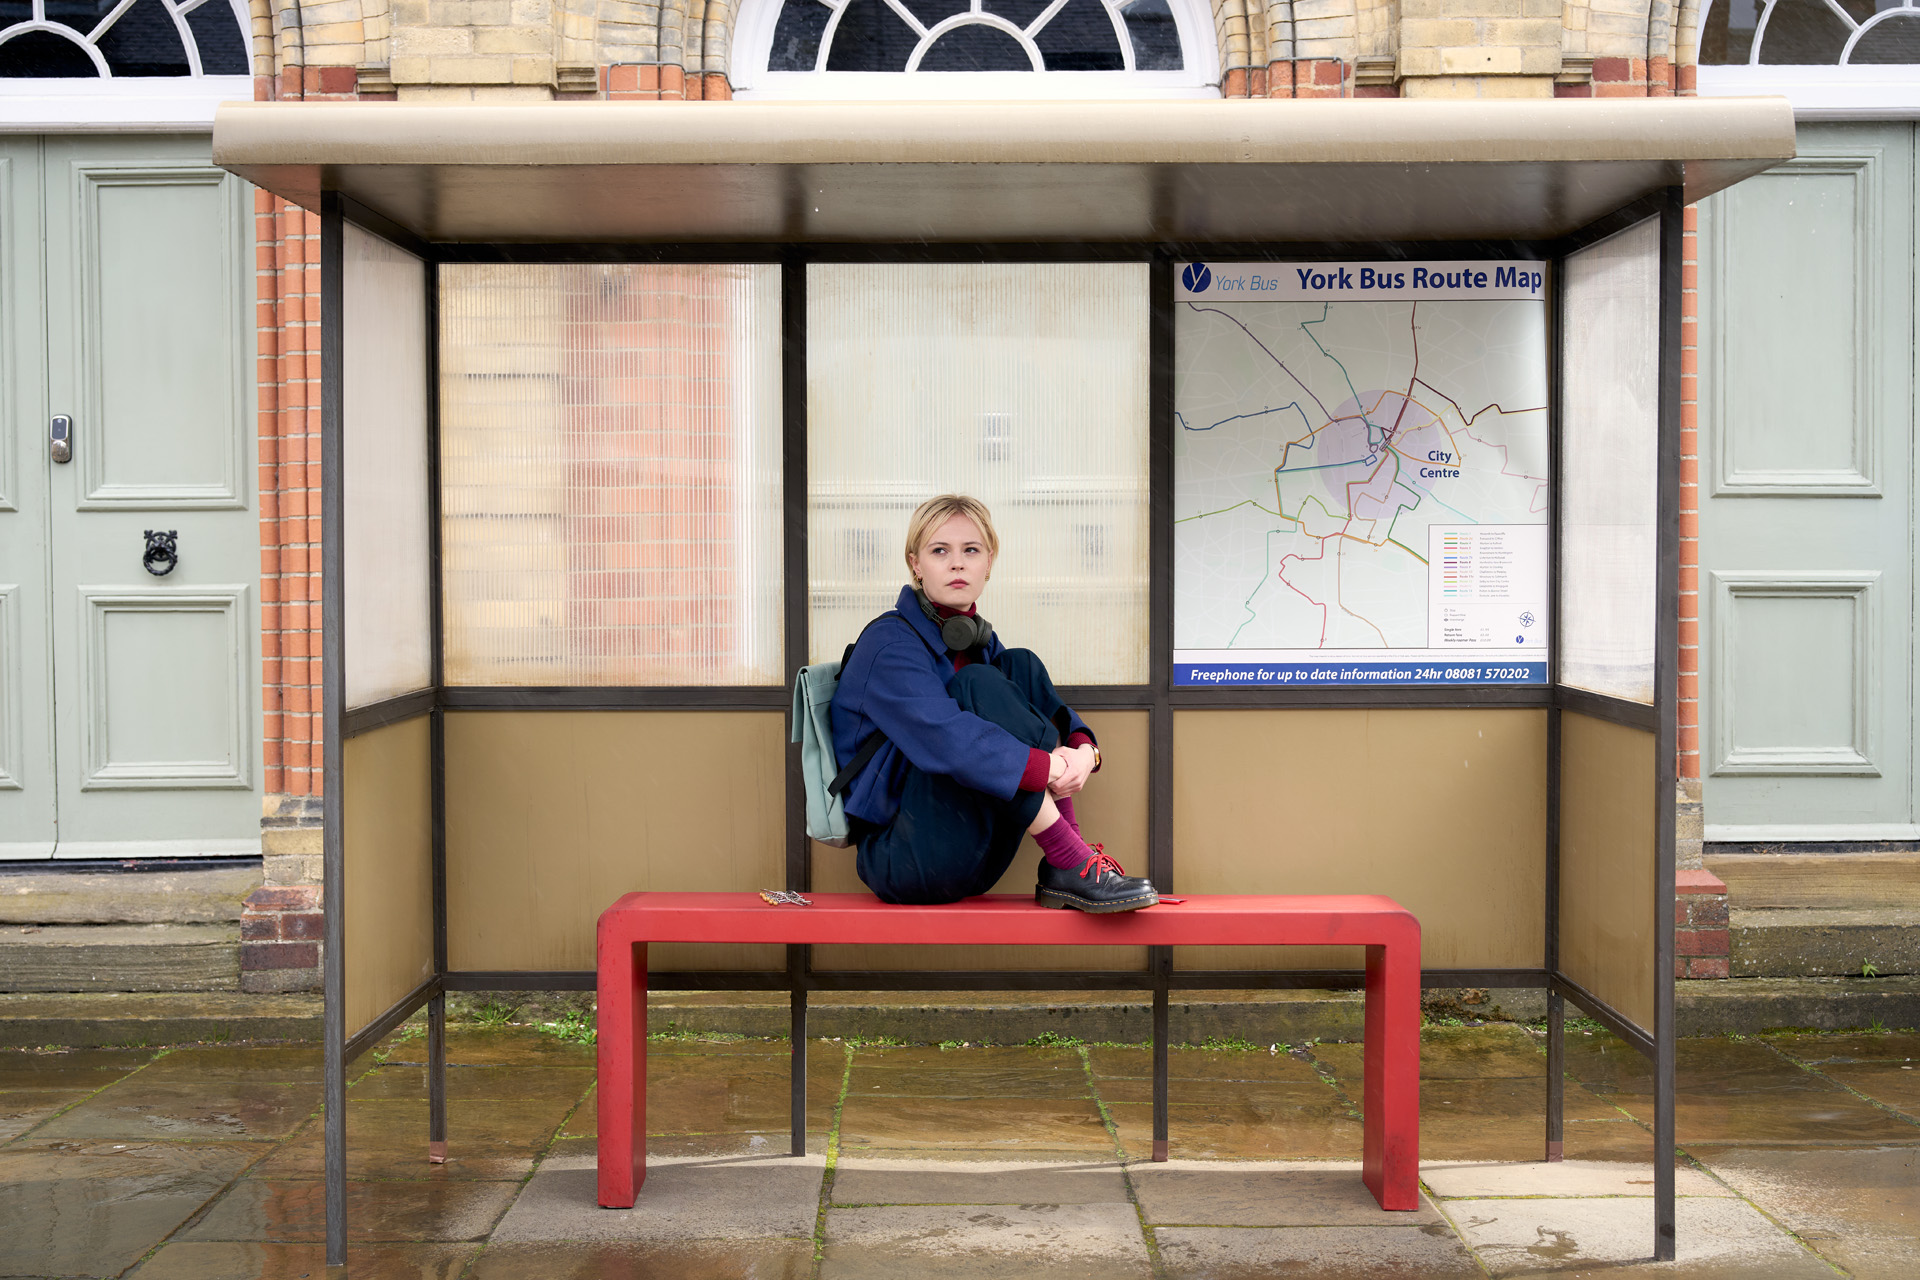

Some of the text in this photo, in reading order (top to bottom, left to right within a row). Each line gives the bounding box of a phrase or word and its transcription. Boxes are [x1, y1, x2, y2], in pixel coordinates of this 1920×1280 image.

[1216, 275, 1278, 290] York Bus
[1296, 266, 1542, 293] York Bus Route Map
[1428, 450, 1452, 464] City
[1419, 467, 1460, 479] Centre
[1190, 668, 1530, 683] Freephone for up to date information 24hr 08081 570202
